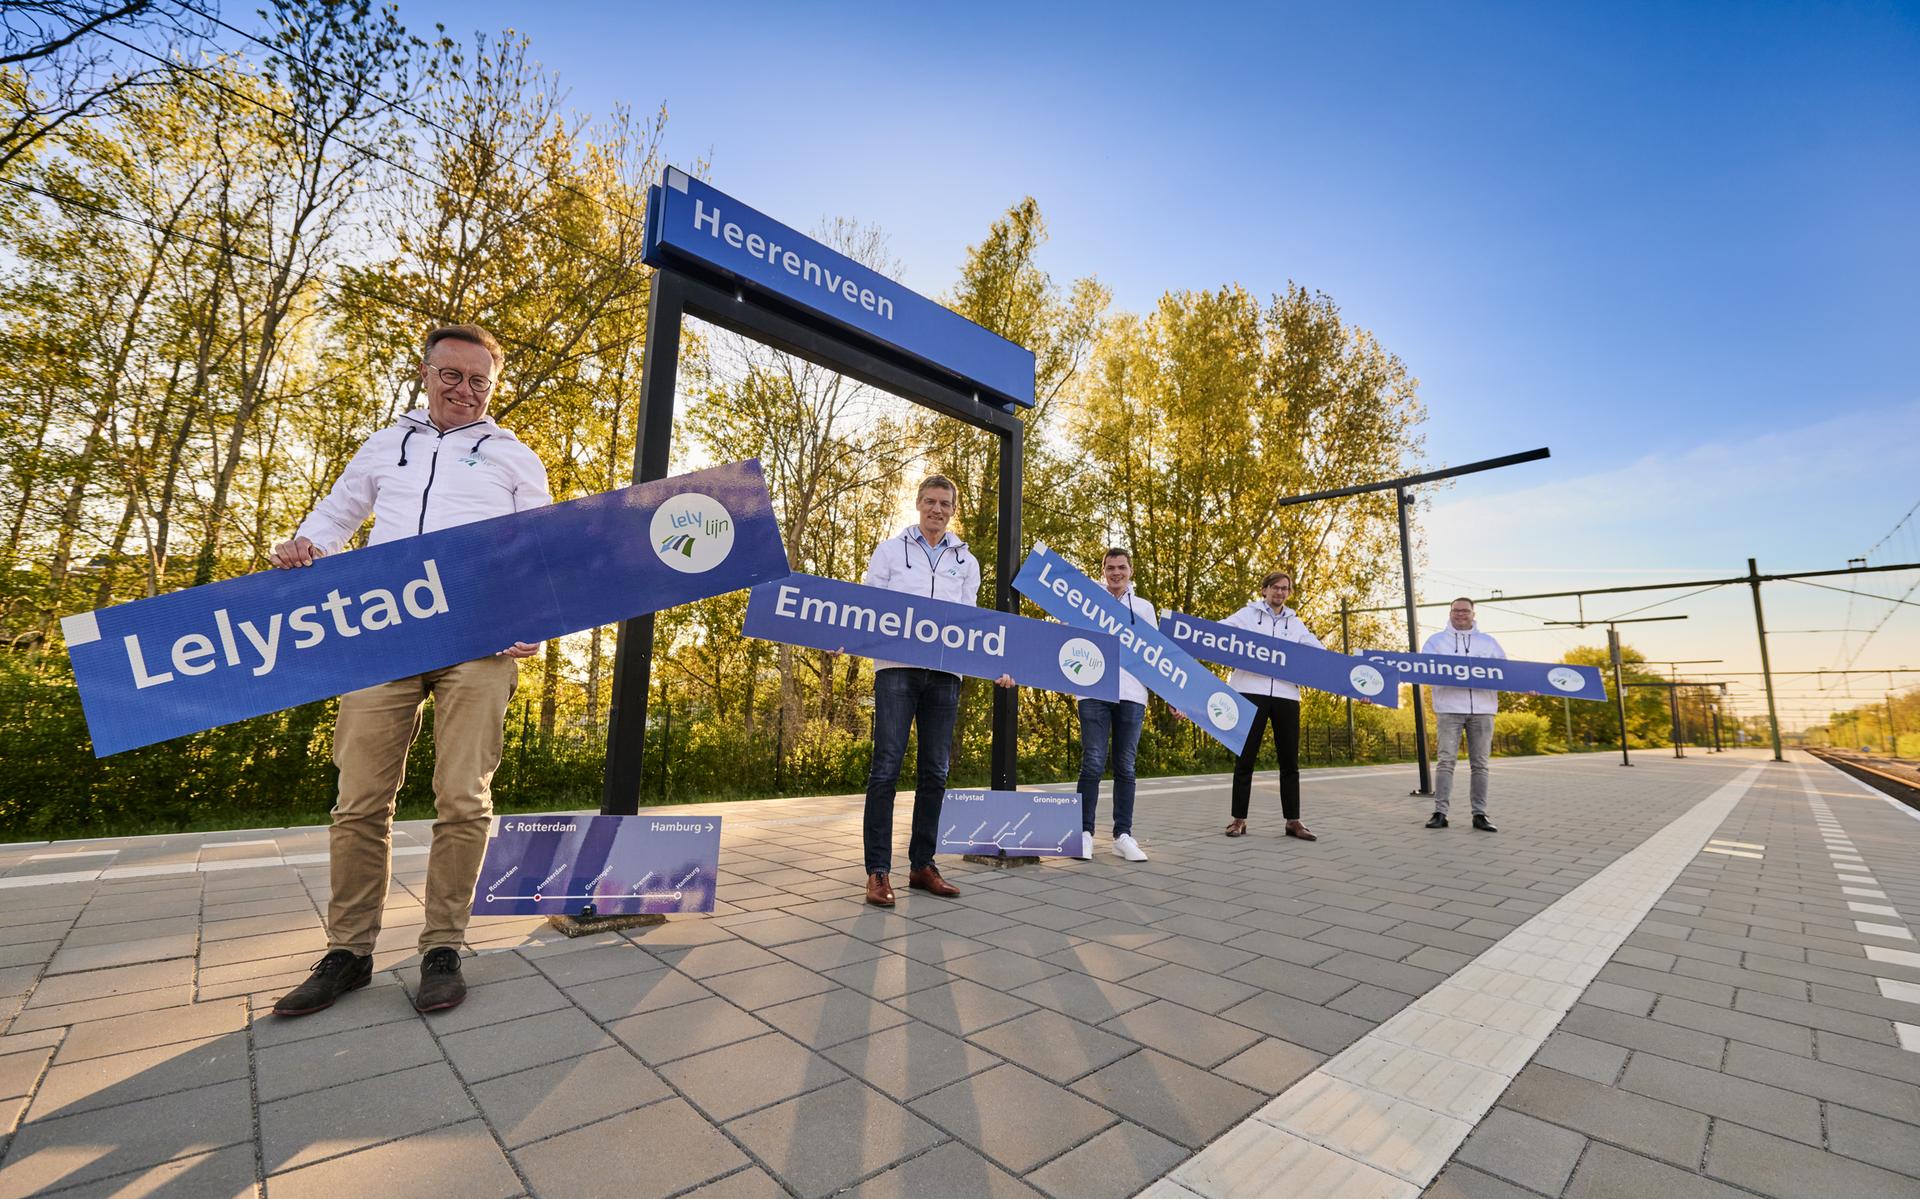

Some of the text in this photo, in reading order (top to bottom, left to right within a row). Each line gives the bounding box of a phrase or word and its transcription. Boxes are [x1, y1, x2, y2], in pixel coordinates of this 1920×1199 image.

[693, 199, 894, 320] Heerenveen
[671, 510, 702, 528] lely
[706, 519, 728, 539] lijn
[124, 559, 450, 690] Lelystad
[774, 585, 1006, 657] Emmeloord
[1038, 562, 1188, 689] Leeuwarden
[1173, 621, 1287, 666] Drachten
[955, 793, 984, 801] Lelystad
[1033, 796, 1070, 804] Groningen
[517, 821, 577, 832] Rotterdam
[651, 821, 702, 834] Hamburg
[488, 865, 518, 892] Rotterdam
[536, 863, 568, 891] Amsterdam
[585, 864, 614, 891] Groningen
[675, 866, 701, 889] Hamburg
